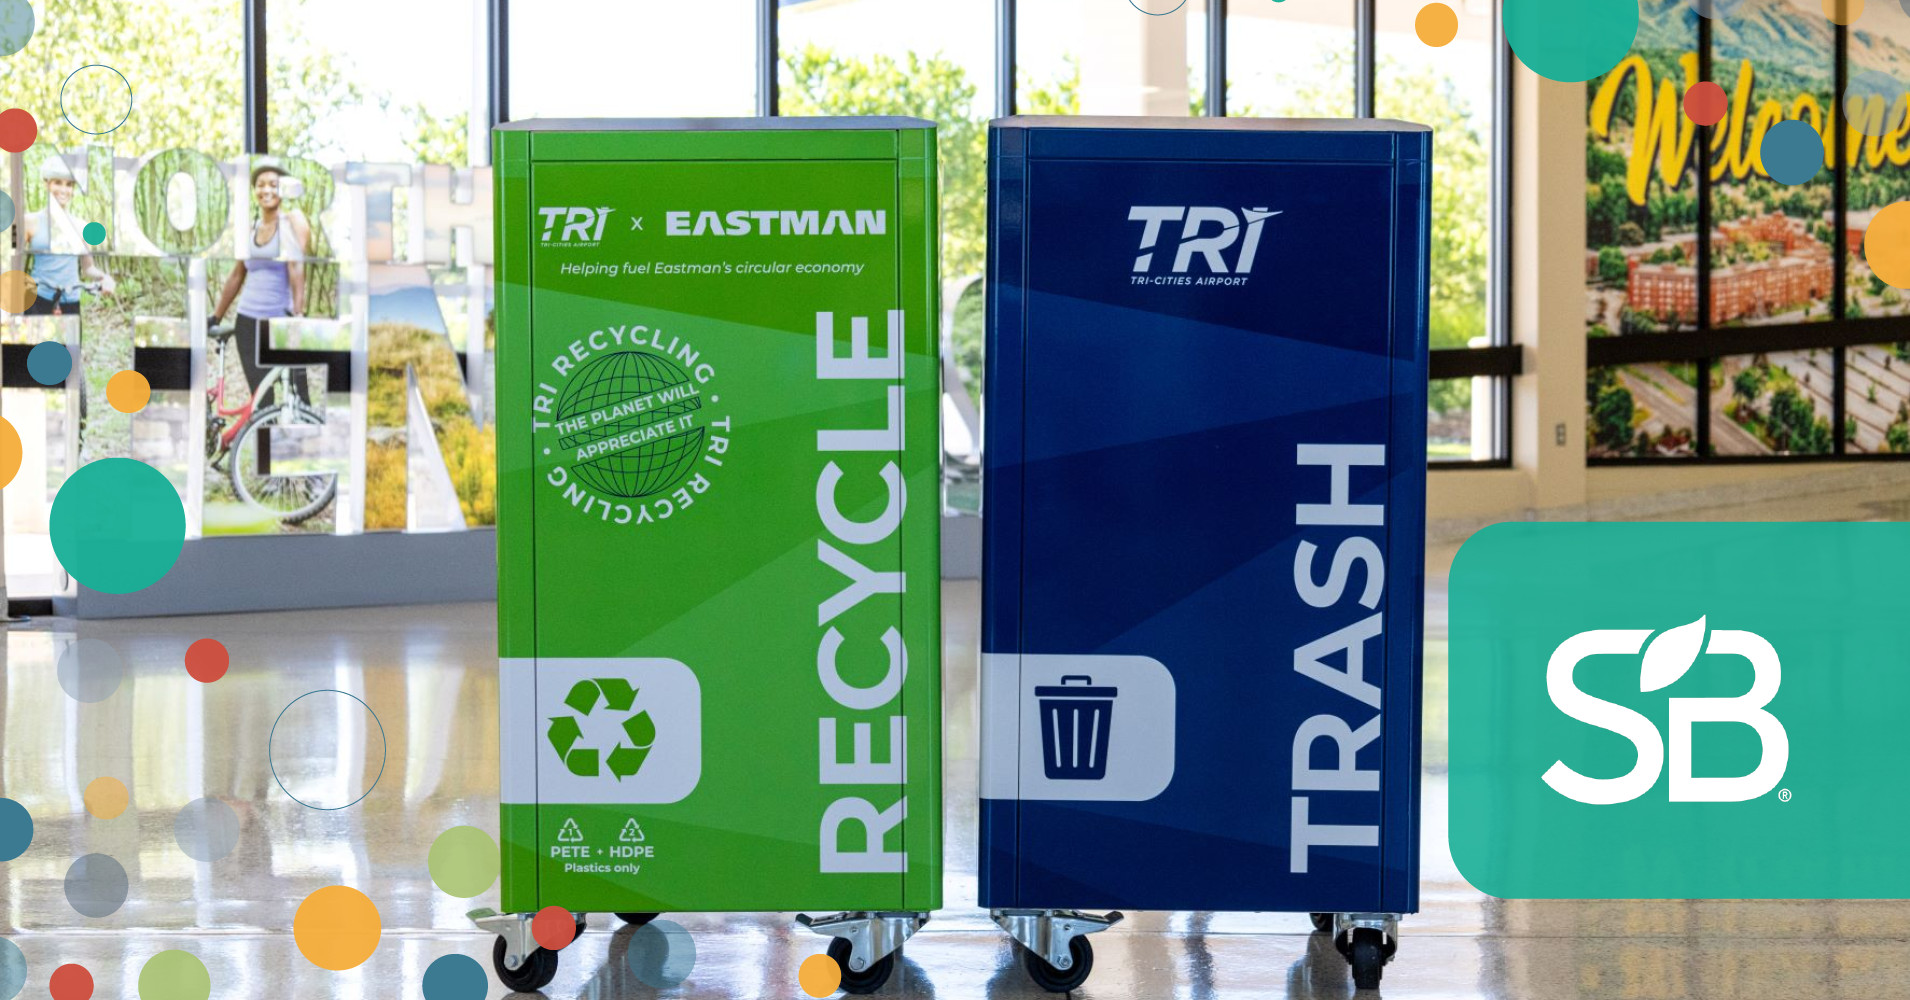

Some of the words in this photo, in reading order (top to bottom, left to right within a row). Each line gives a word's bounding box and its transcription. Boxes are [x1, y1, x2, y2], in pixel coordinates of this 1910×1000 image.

[20, 143, 496, 267] NORTH
[538, 206, 616, 241] TRI
[666, 210, 887, 236] EASTMAN
[1128, 206, 1283, 273] TRI
[560, 261, 619, 277] Helping
[622, 261, 651, 275] fuel
[654, 261, 732, 275] Eastman's
[736, 261, 792, 274] circular
[795, 263, 864, 276] economy
[1130, 276, 1192, 286] TRI-CITIES
[1195, 276, 1249, 286] AIRPORT
[532, 382, 558, 434] TRI
[551, 325, 715, 384] RECYCLING
[554, 415, 592, 435] THE
[590, 396, 655, 425] PLANET
[656, 383, 700, 405] WILL
[576, 420, 677, 461] APPRECIATE
[678, 414, 694, 430] IT
[704, 415, 731, 467] TRI
[547, 466, 711, 525] RECYCLING
[815, 309, 908, 874] RECYCLE
[1290, 443, 1386, 873] TRASH
[550, 846, 590, 858] PETE
[609, 846, 655, 858] HDPE
[564, 862, 611, 873] Plastics
[613, 862, 640, 875] only
